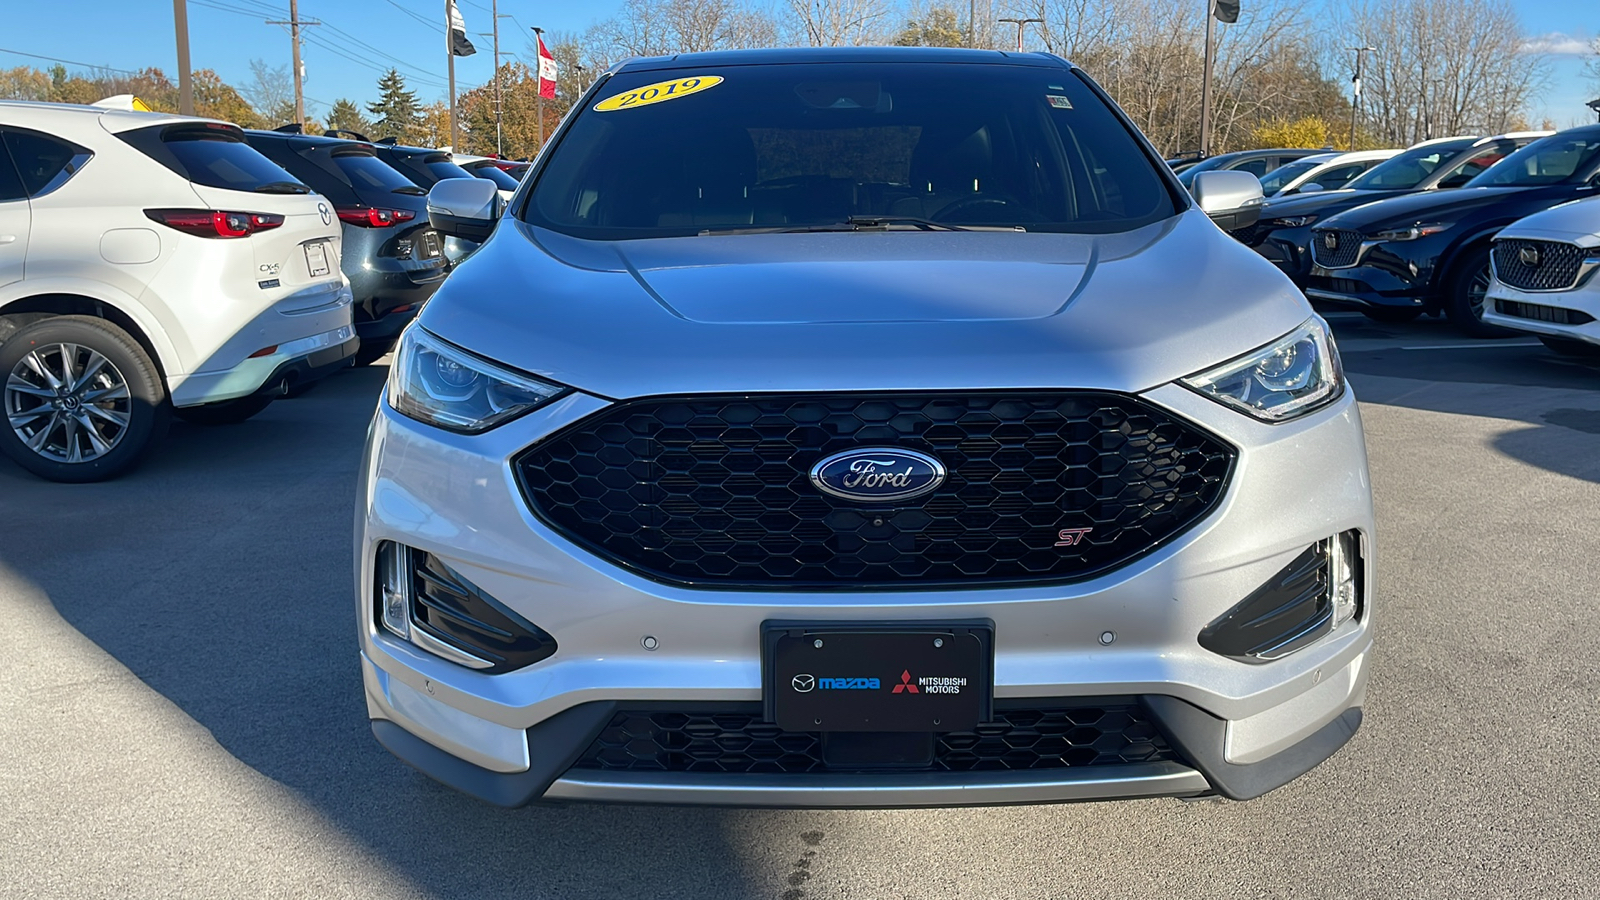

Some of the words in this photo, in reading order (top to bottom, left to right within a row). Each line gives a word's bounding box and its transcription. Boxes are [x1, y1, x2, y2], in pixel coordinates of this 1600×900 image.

[618, 79, 701, 107] 2019
[842, 459, 914, 488] Ford
[1054, 527, 1093, 546] ST
[918, 677, 967, 686] MITSUBISHI
[925, 685, 960, 694] MOTORS
